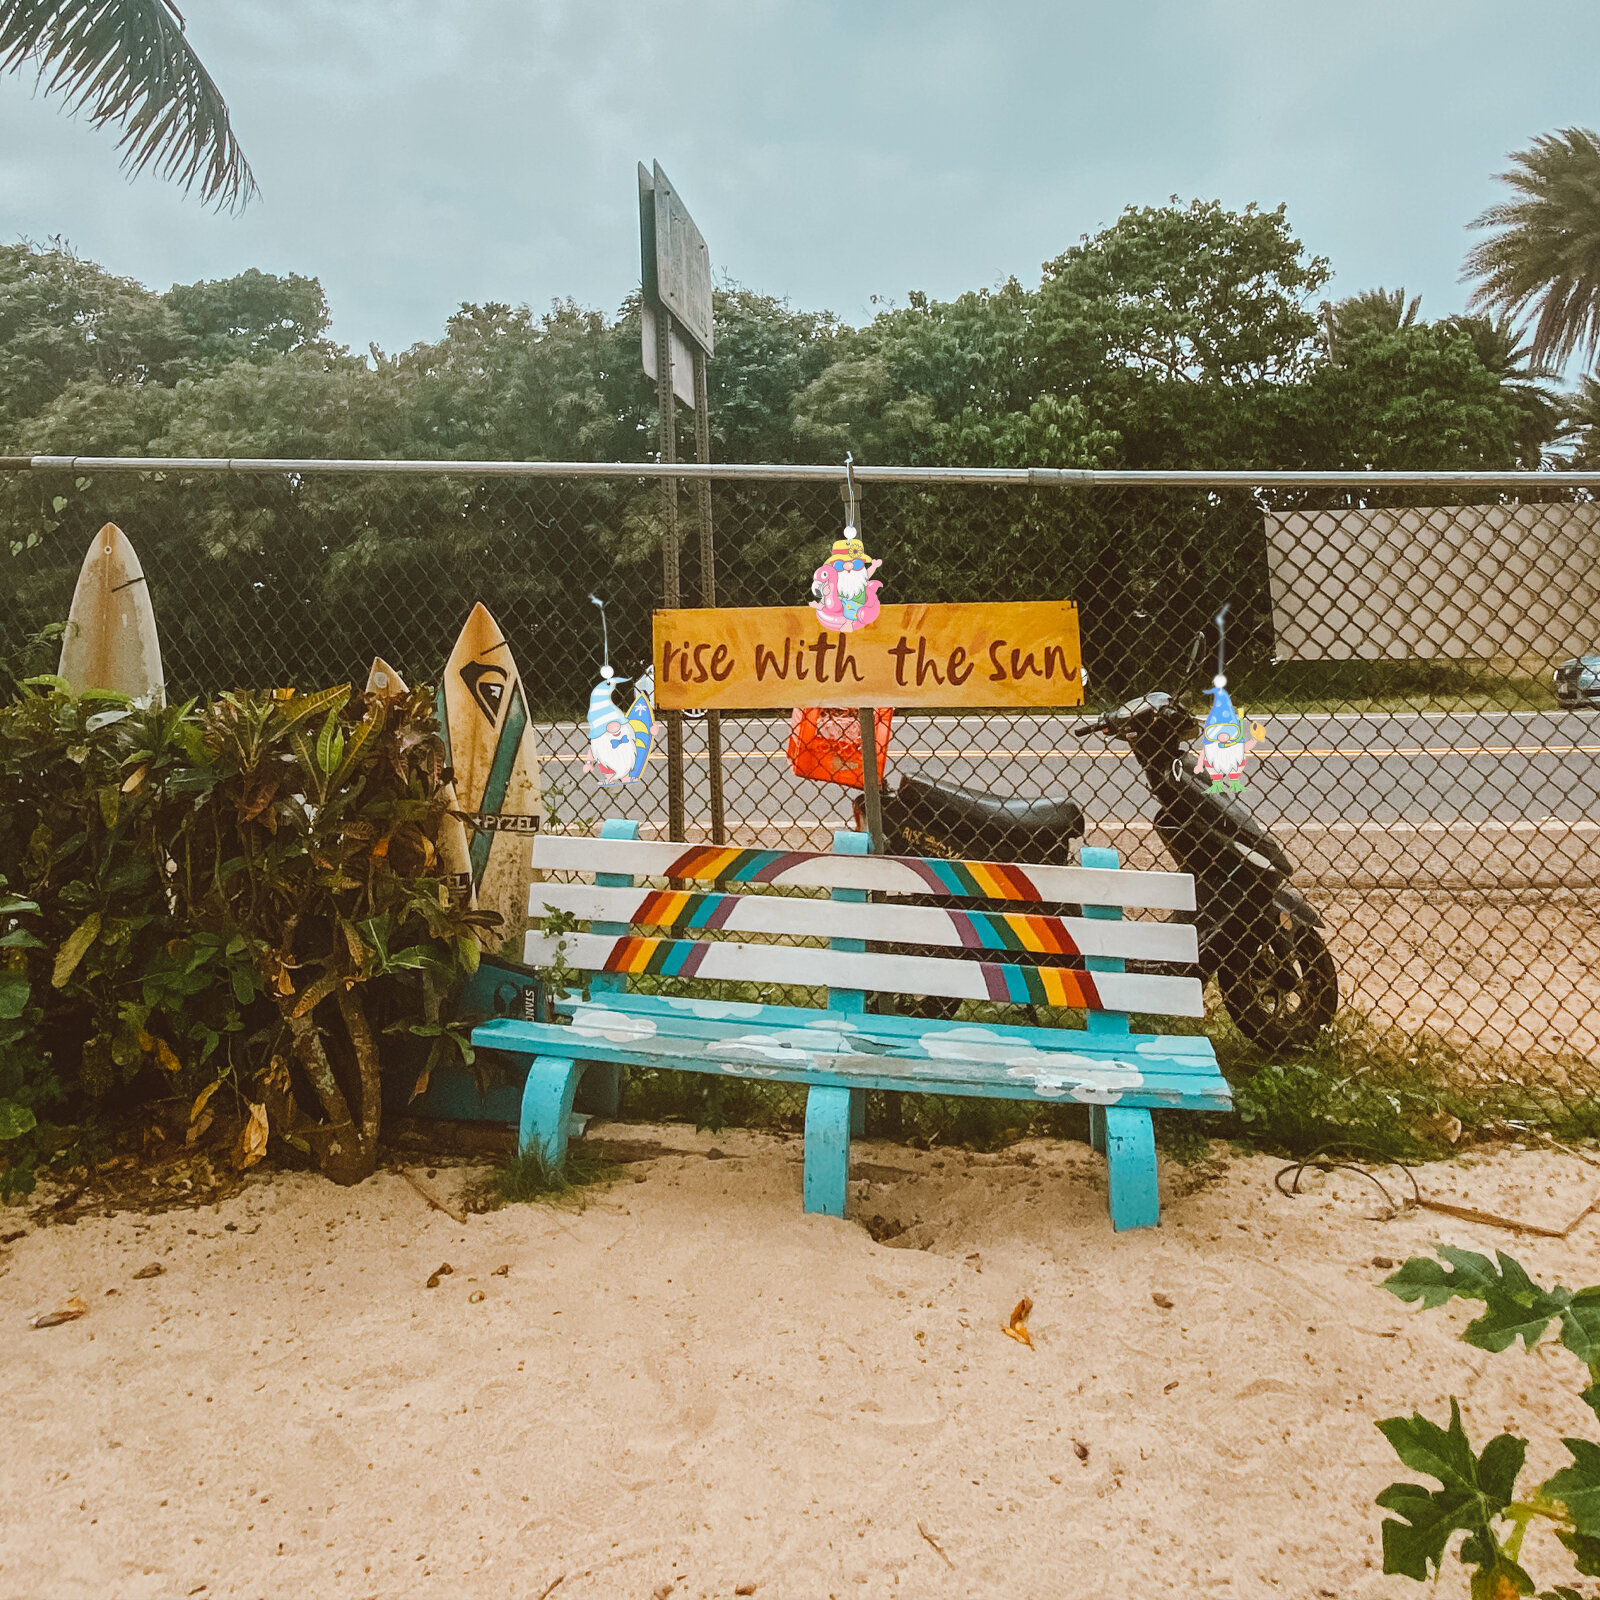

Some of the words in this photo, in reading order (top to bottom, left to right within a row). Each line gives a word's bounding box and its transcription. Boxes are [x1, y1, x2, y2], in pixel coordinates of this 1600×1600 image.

[662, 640, 735, 683] rise
[888, 635, 975, 687] the
[988, 639, 1077, 682] sun
[483, 815, 537, 832] PYZEL
